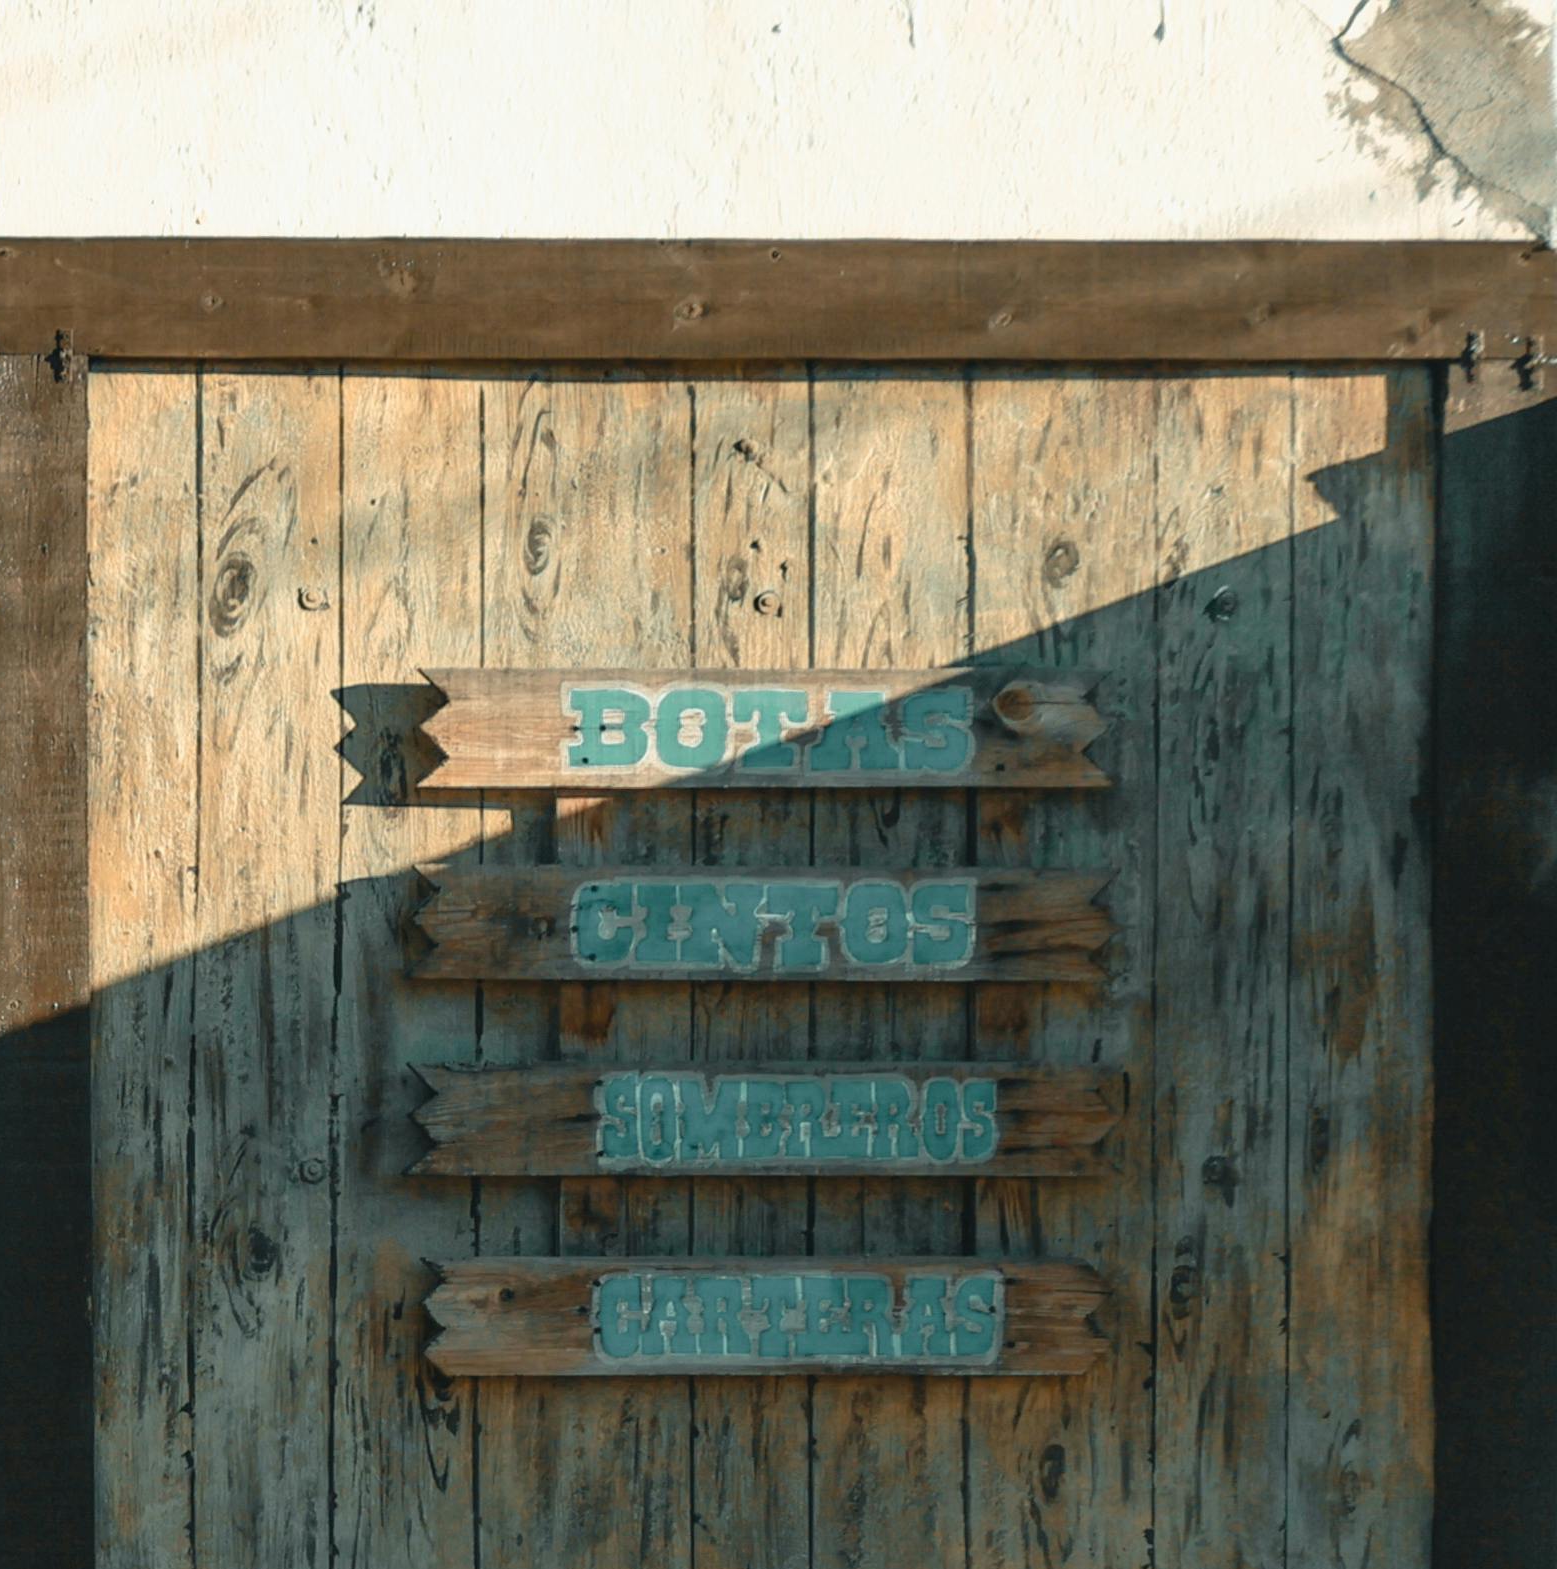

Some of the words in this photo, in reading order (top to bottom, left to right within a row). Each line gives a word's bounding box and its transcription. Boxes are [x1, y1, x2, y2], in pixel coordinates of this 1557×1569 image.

[565, 687, 973, 770] BOTAS
[572, 880, 977, 971] CINTOS
[599, 1074, 998, 1164] SOMBREROS
[596, 1273, 997, 1361] CARTERAS
